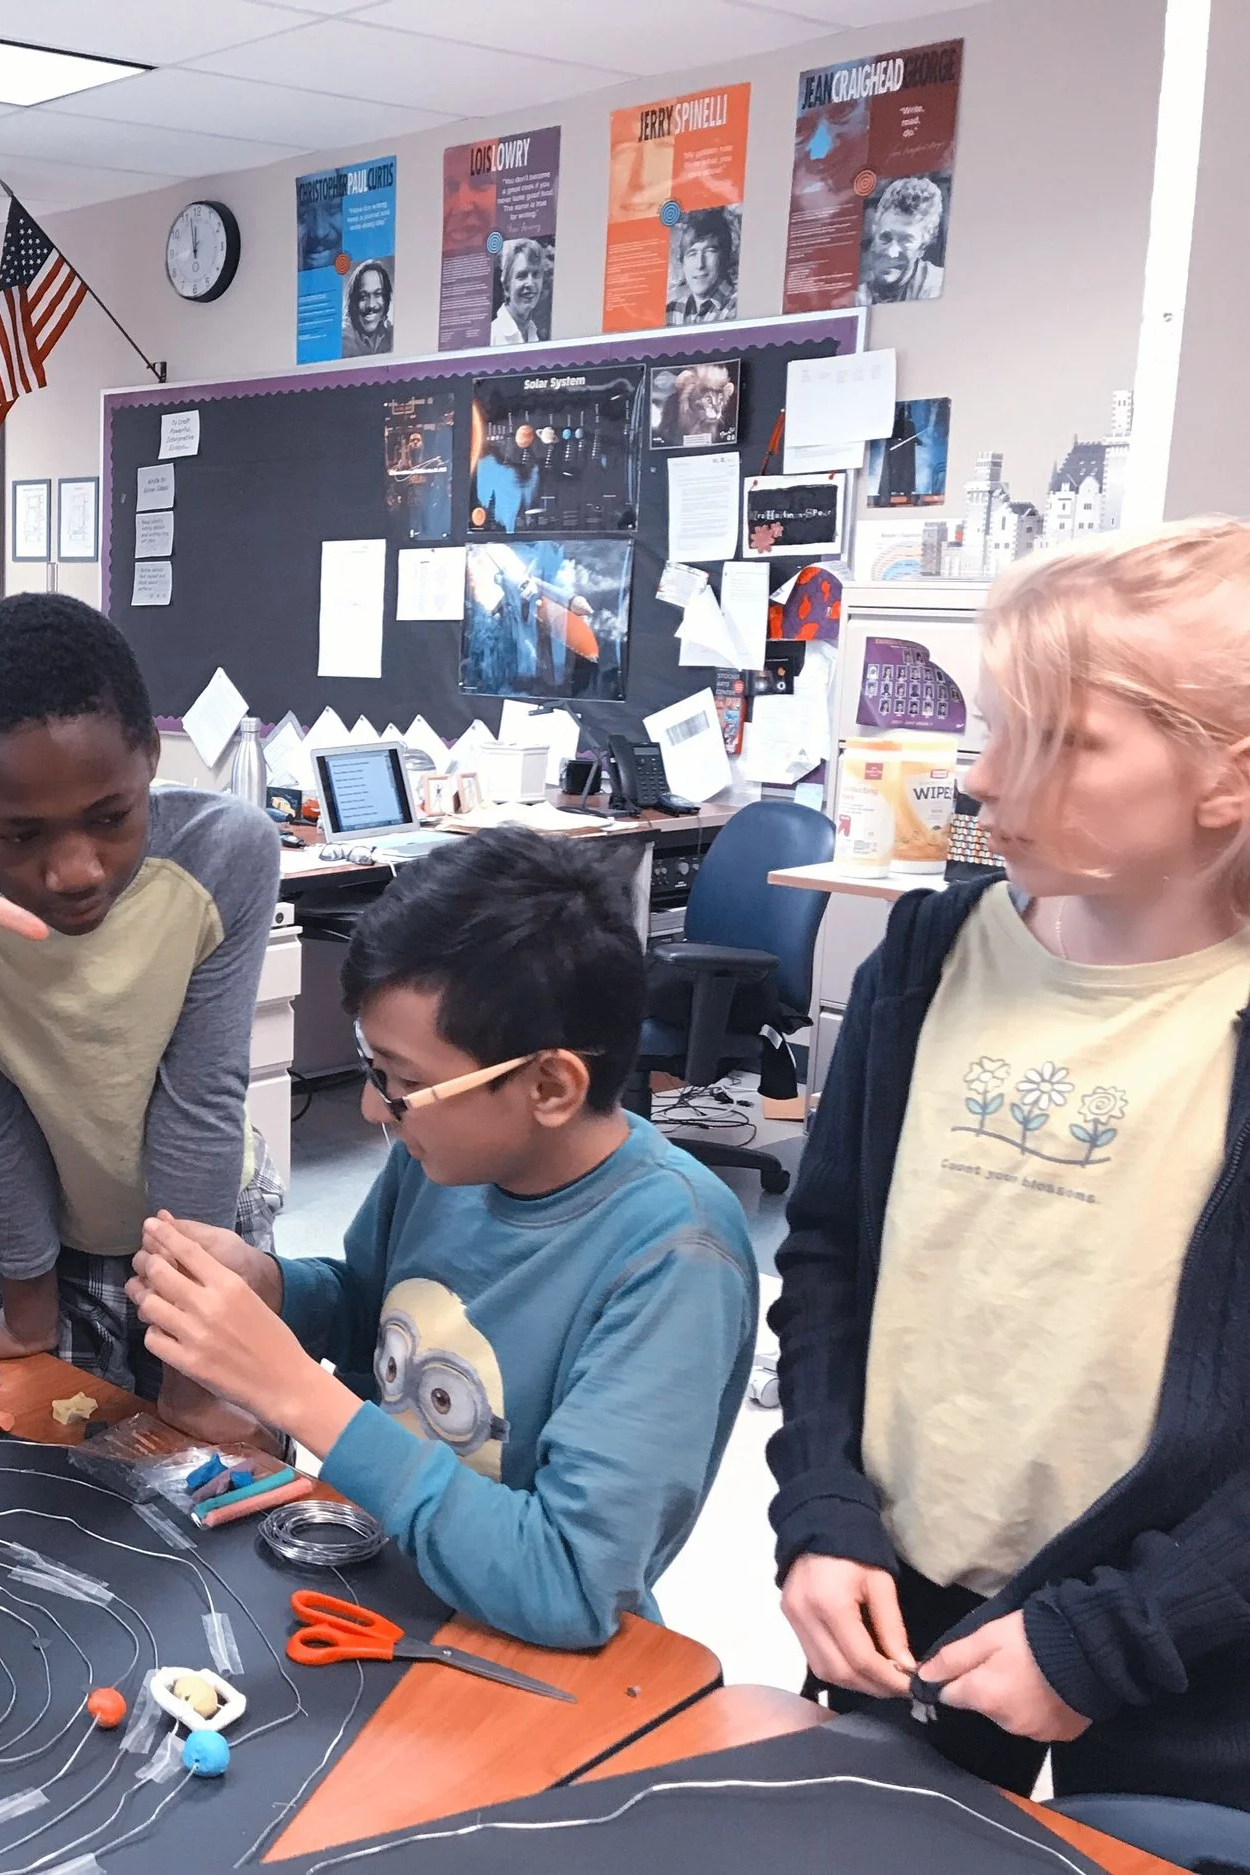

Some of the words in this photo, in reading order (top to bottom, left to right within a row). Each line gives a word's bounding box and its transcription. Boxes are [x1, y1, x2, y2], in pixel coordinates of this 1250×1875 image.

[801, 72, 833, 110] JEAN
[831, 58, 904, 103] CRAIGHEAD
[638, 105, 673, 143] JERRY
[674, 93, 728, 135] SPINELLI
[470, 145, 492, 176] LOIS
[491, 138, 530, 172] LOWRY
[299, 173, 348, 202] CHRISTOPHER
[347, 169, 368, 195] PAUL
[367, 163, 394, 191] CURTIS
[524, 378, 548, 390] Solar
[550, 376, 586, 390] System
[913, 786, 954, 800] WIPE
